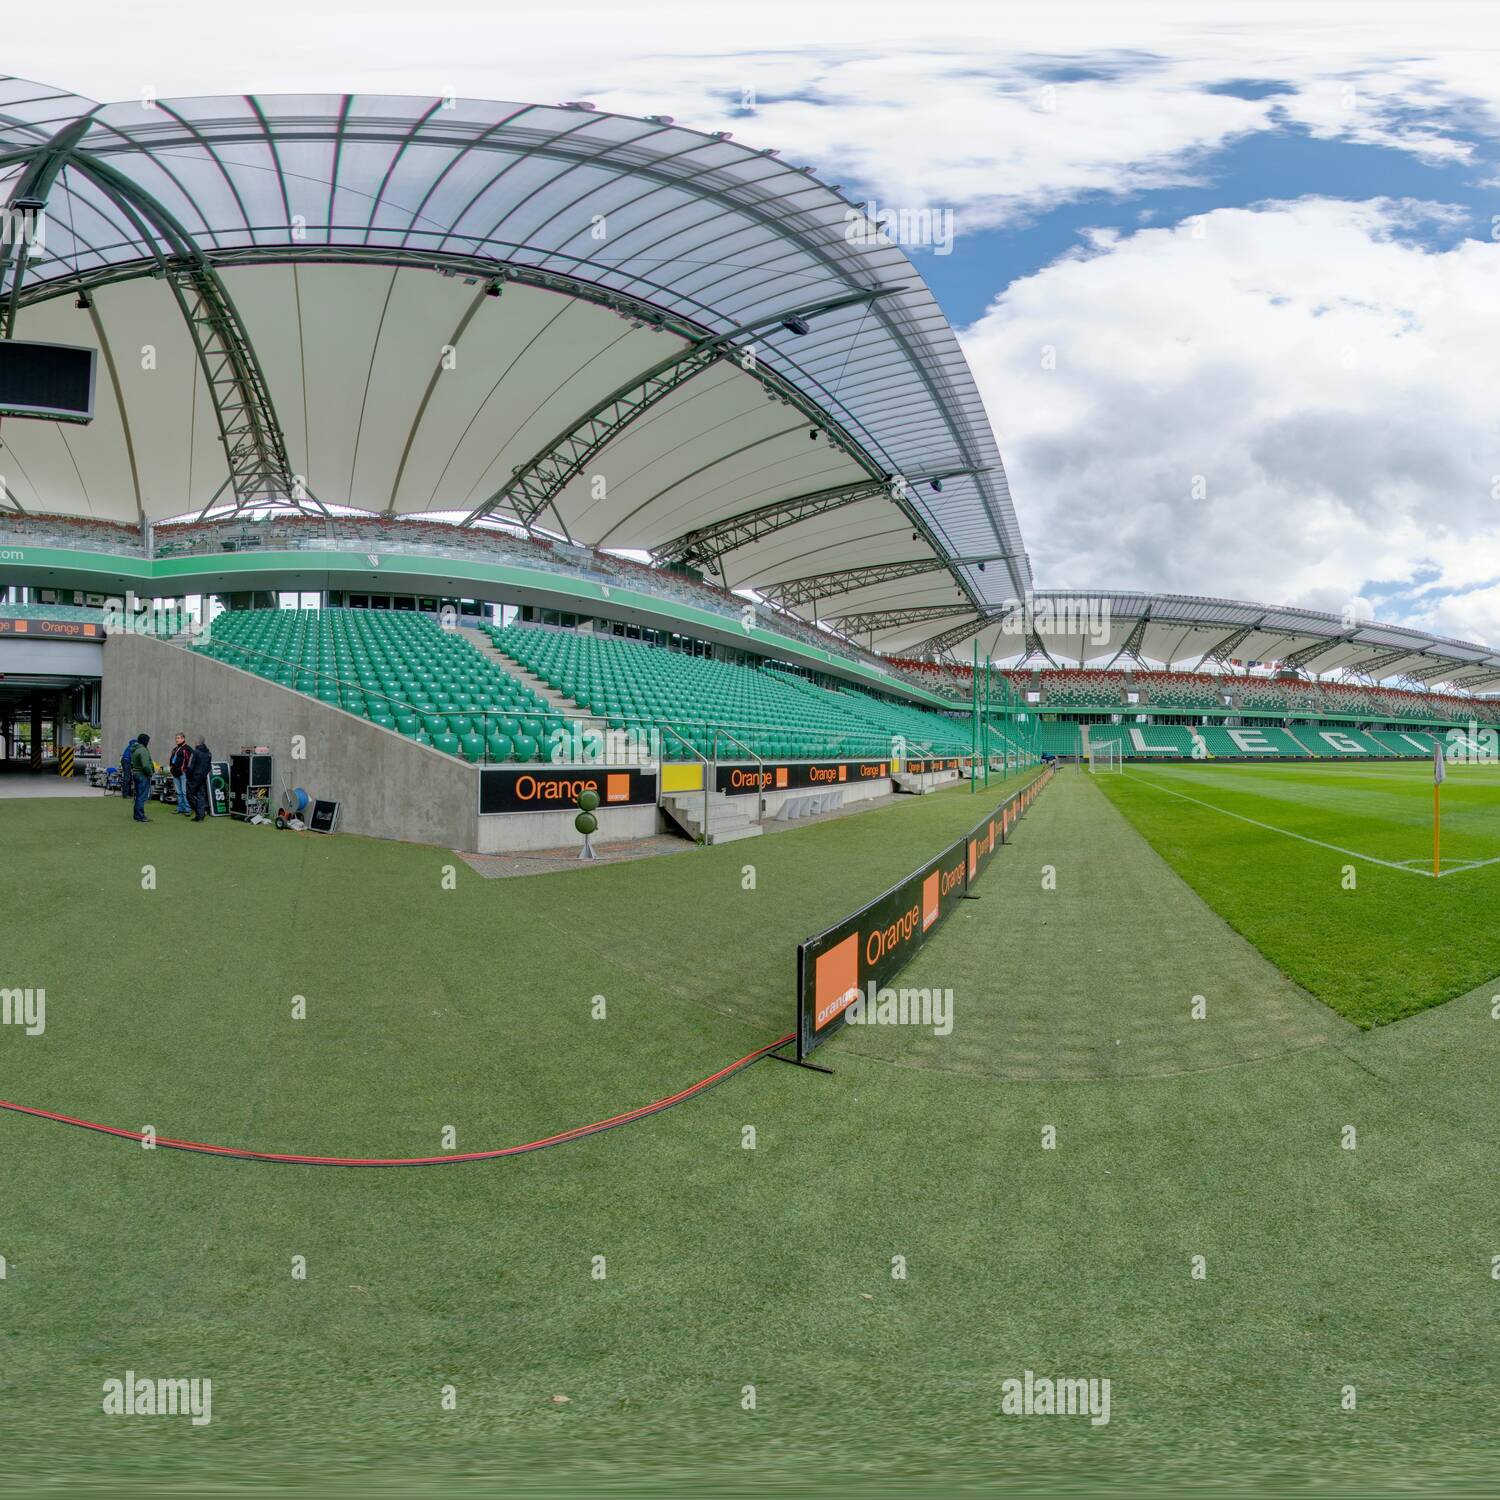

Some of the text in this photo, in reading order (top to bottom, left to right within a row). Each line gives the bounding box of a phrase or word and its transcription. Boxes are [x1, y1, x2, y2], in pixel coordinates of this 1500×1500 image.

[41, 621, 80, 635] Orange
[809, 766, 837, 783] Orange
[866, 904, 920, 966] Orange
